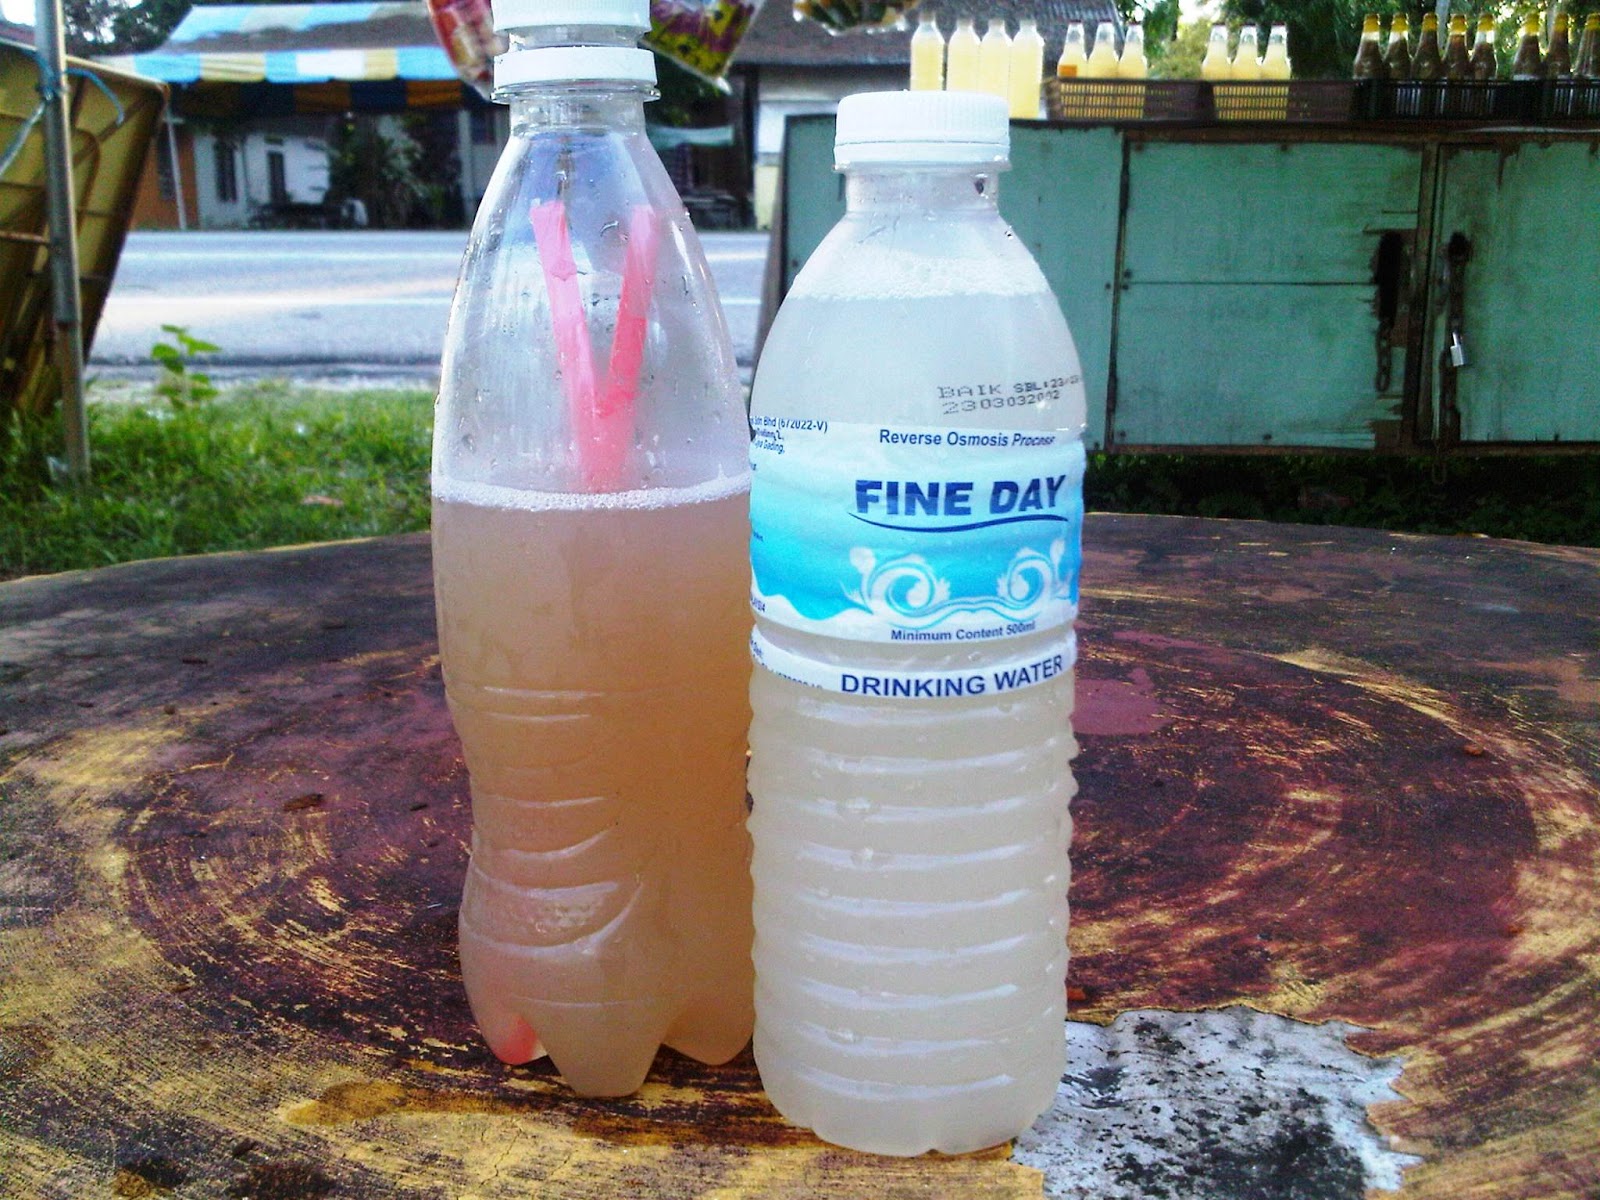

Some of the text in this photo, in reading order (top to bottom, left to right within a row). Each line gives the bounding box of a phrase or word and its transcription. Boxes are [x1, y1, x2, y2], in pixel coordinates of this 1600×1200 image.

[937, 384, 1001, 398] BAIK
[879, 429, 942, 446] Reverse
[946, 431, 1008, 447] Osmosis
[855, 474, 1066, 516] FINE DAY
[890, 620, 1037, 641] Minimum Content 500ml
[841, 673, 986, 697] DRINKING
[994, 654, 1064, 690] WATER
